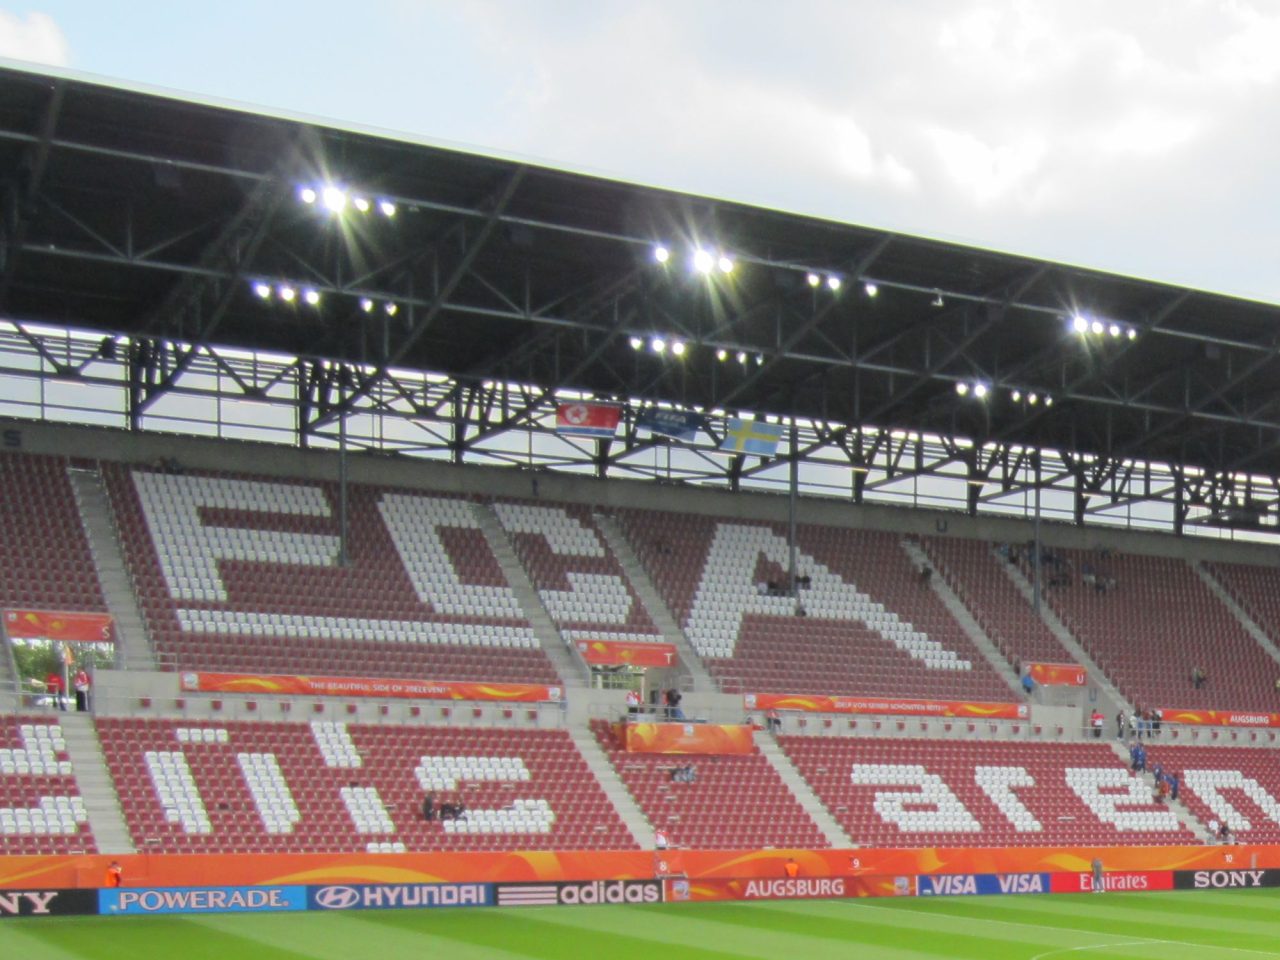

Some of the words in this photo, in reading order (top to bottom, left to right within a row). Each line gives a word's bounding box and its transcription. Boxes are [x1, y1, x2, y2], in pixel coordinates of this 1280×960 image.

[101, 626, 111, 639] S
[664, 653, 673, 664] T
[1076, 674, 1084, 684] U
[1230, 715, 1270, 725] AUGSBURG
[853, 858, 860, 869] 9
[1224, 854, 1233, 864] 10
[745, 878, 844, 897] AUGSBURG
[930, 874, 977, 895] VISA
[998, 873, 1043, 893] VISA
[1194, 870, 1265, 888] SONY
[120, 889, 282, 911] POWERADE
[364, 884, 485, 907] HYUNDAI
[560, 880, 658, 904] adidas
